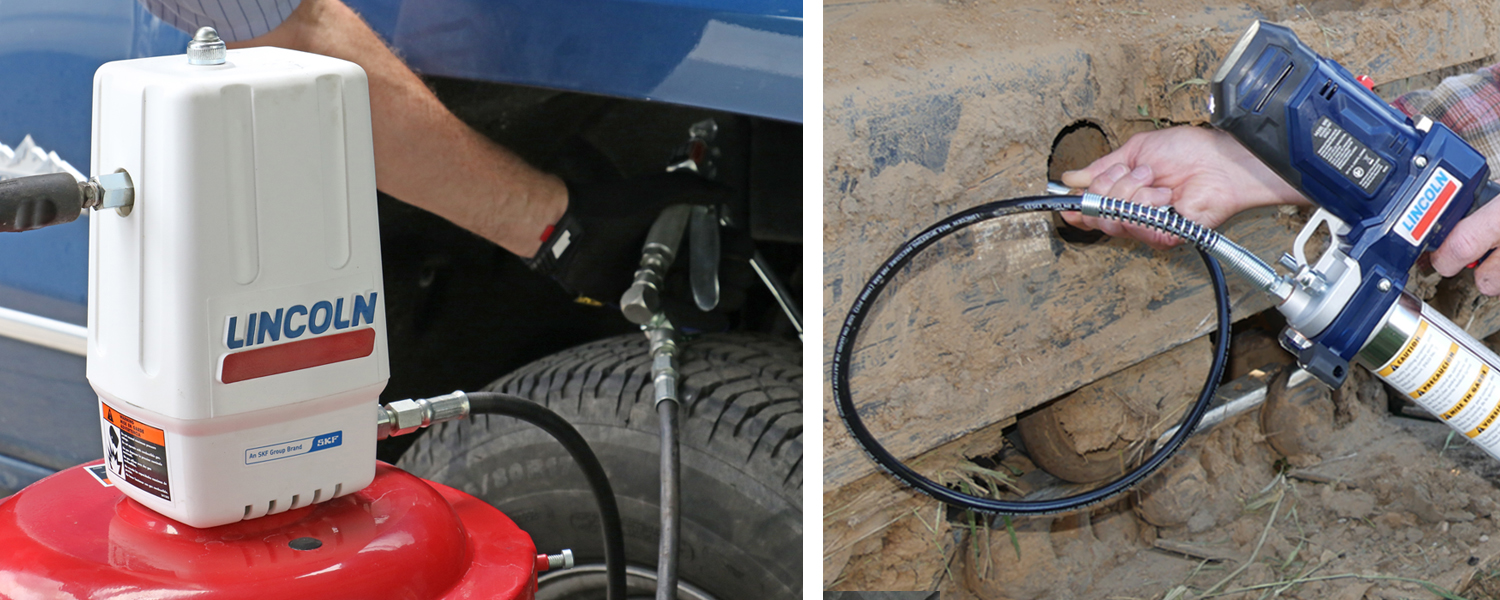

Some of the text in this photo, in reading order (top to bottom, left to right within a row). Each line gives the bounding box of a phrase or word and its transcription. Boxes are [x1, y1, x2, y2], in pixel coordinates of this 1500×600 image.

[1402, 171, 1448, 231] LINCOLN
[228, 292, 377, 350] LINCOLN
[1397, 336, 1420, 364] CAUTION
[287, 444, 302, 452] Brand
[317, 435, 339, 447] SKF
